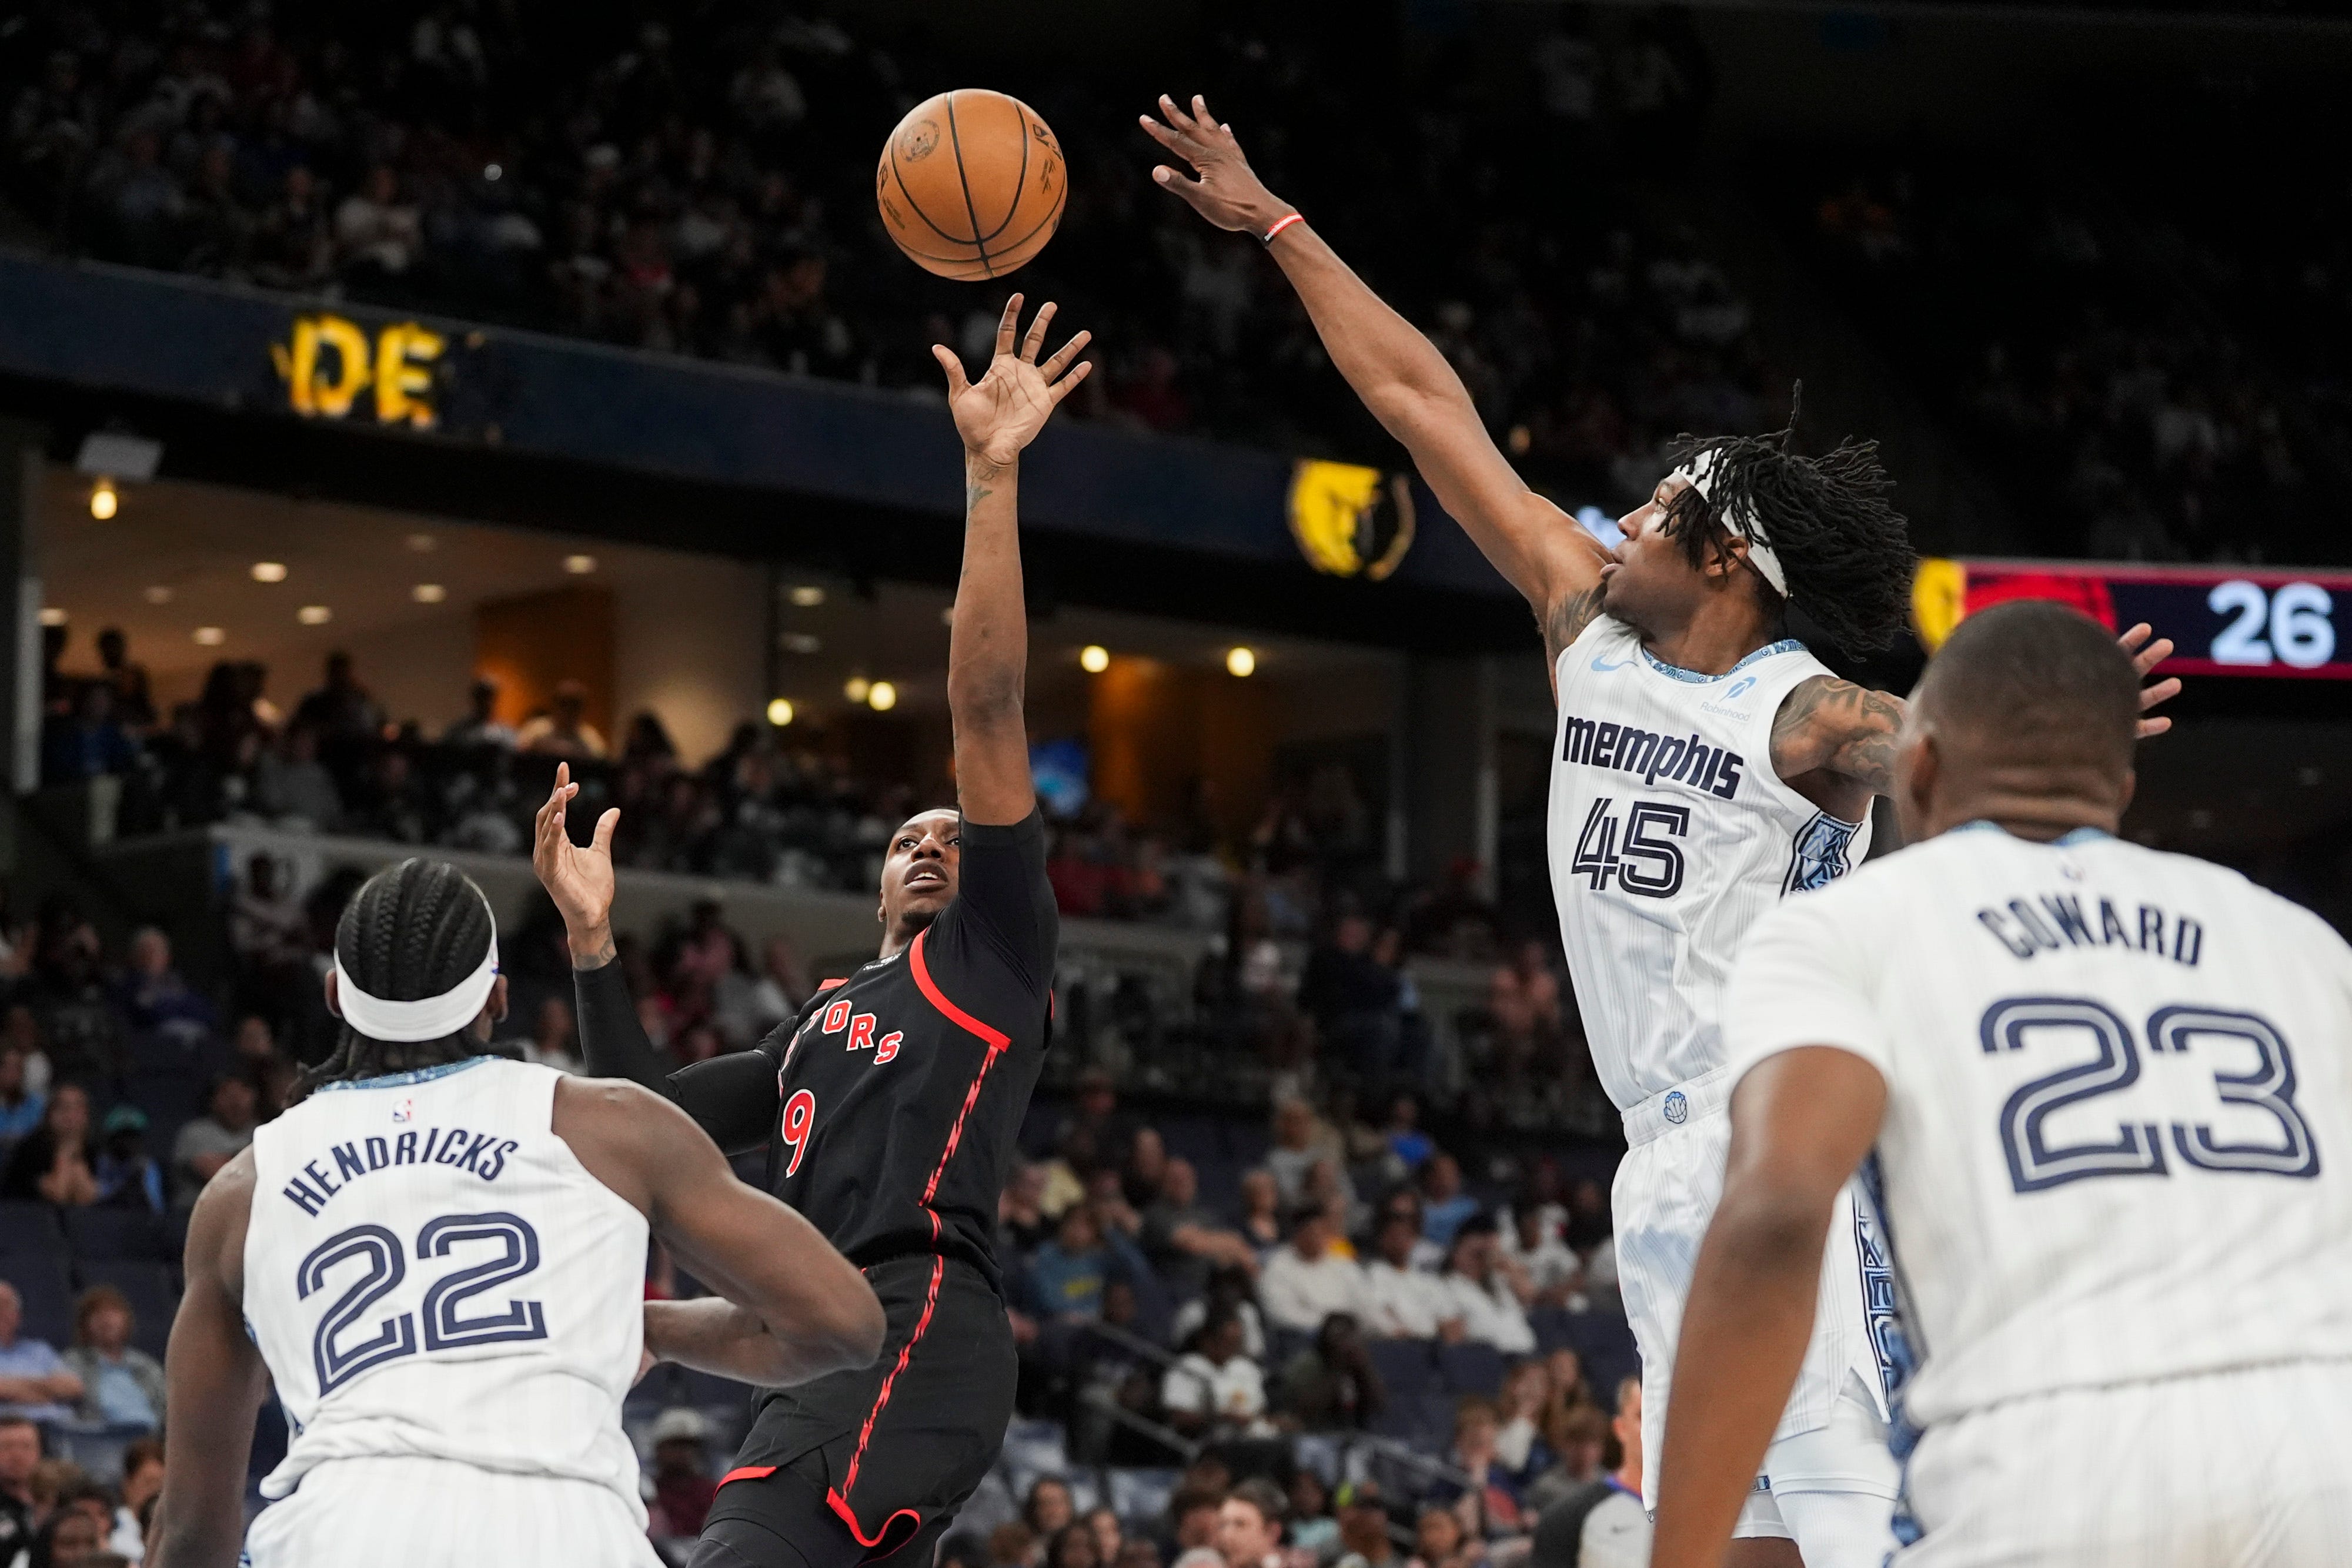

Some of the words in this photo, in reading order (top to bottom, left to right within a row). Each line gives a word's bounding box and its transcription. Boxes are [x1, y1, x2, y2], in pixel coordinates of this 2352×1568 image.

[2208, 580, 2334, 668] 26
[1700, 701, 1751, 721] Robinhood
[1562, 716, 1743, 800] memphis
[1571, 797, 1690, 898] 45
[1978, 892, 2203, 966] COWARD
[782, 1089, 816, 1179] 9
[1980, 997, 2321, 1193] 23
[282, 1128, 518, 1218] HENDRICKS
[298, 1212, 548, 1398] 22
